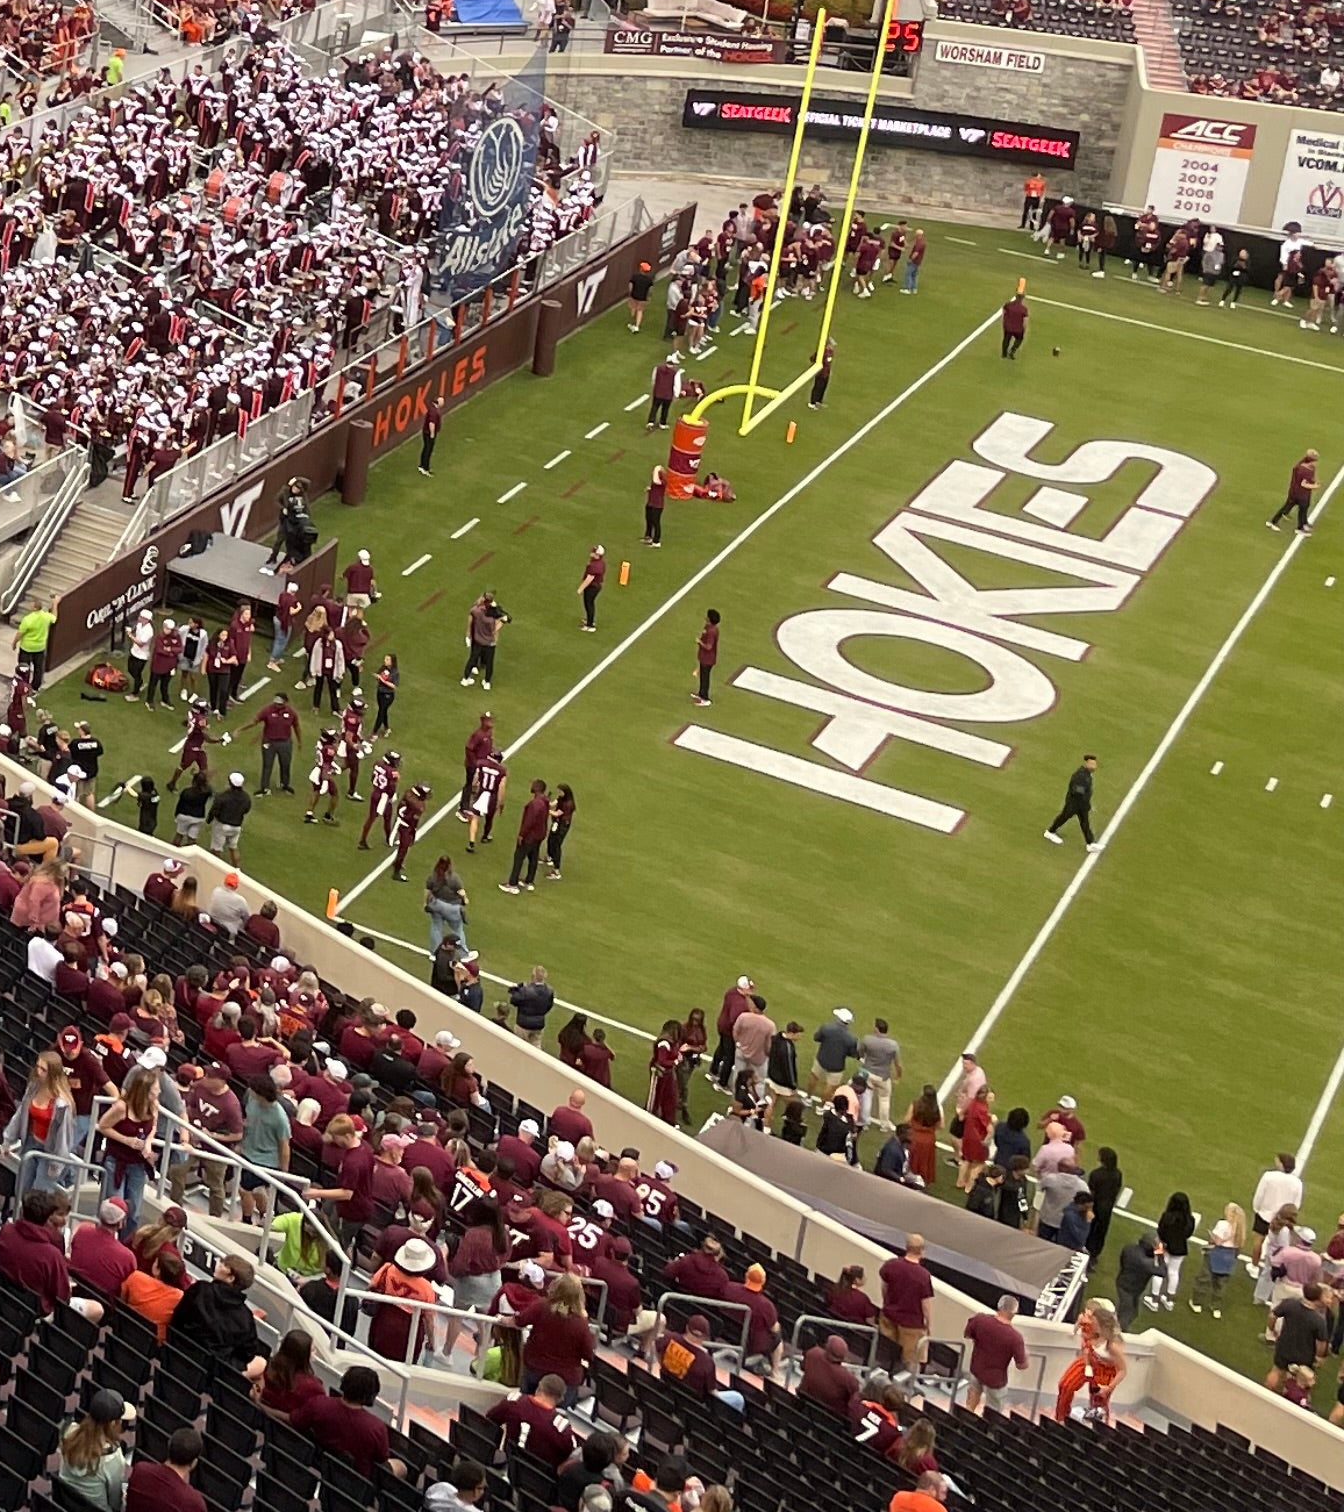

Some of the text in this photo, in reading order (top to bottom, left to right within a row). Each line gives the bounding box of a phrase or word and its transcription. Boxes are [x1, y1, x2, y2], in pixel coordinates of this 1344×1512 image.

[613, 31, 653, 45] CMG
[884, 22, 920, 51] 25
[939, 43, 1042, 71] WORSHAM FIELD
[691, 101, 716, 116] VT
[720, 102, 792, 124] SEATGEEK
[958, 126, 987, 143] VT
[990, 130, 1072, 159] SEATGEEK
[1170, 120, 1248, 145] ACC
[1296, 135, 1340, 150] Medical
[1181, 158, 1219, 173] 2004
[1178, 172, 1217, 187] 2007
[1176, 186, 1215, 201] 2008
[1173, 199, 1212, 214] 2010
[577, 265, 608, 318] VT
[373, 345, 487, 447] HOKIES
[220, 478, 265, 539] VT
[674, 411, 1218, 835] HOKIES
[198, 1098, 220, 1118] VT
[450, 1182, 474, 1211] 17
[567, 1216, 604, 1250] 25
[855, 1417, 880, 1442] 7
